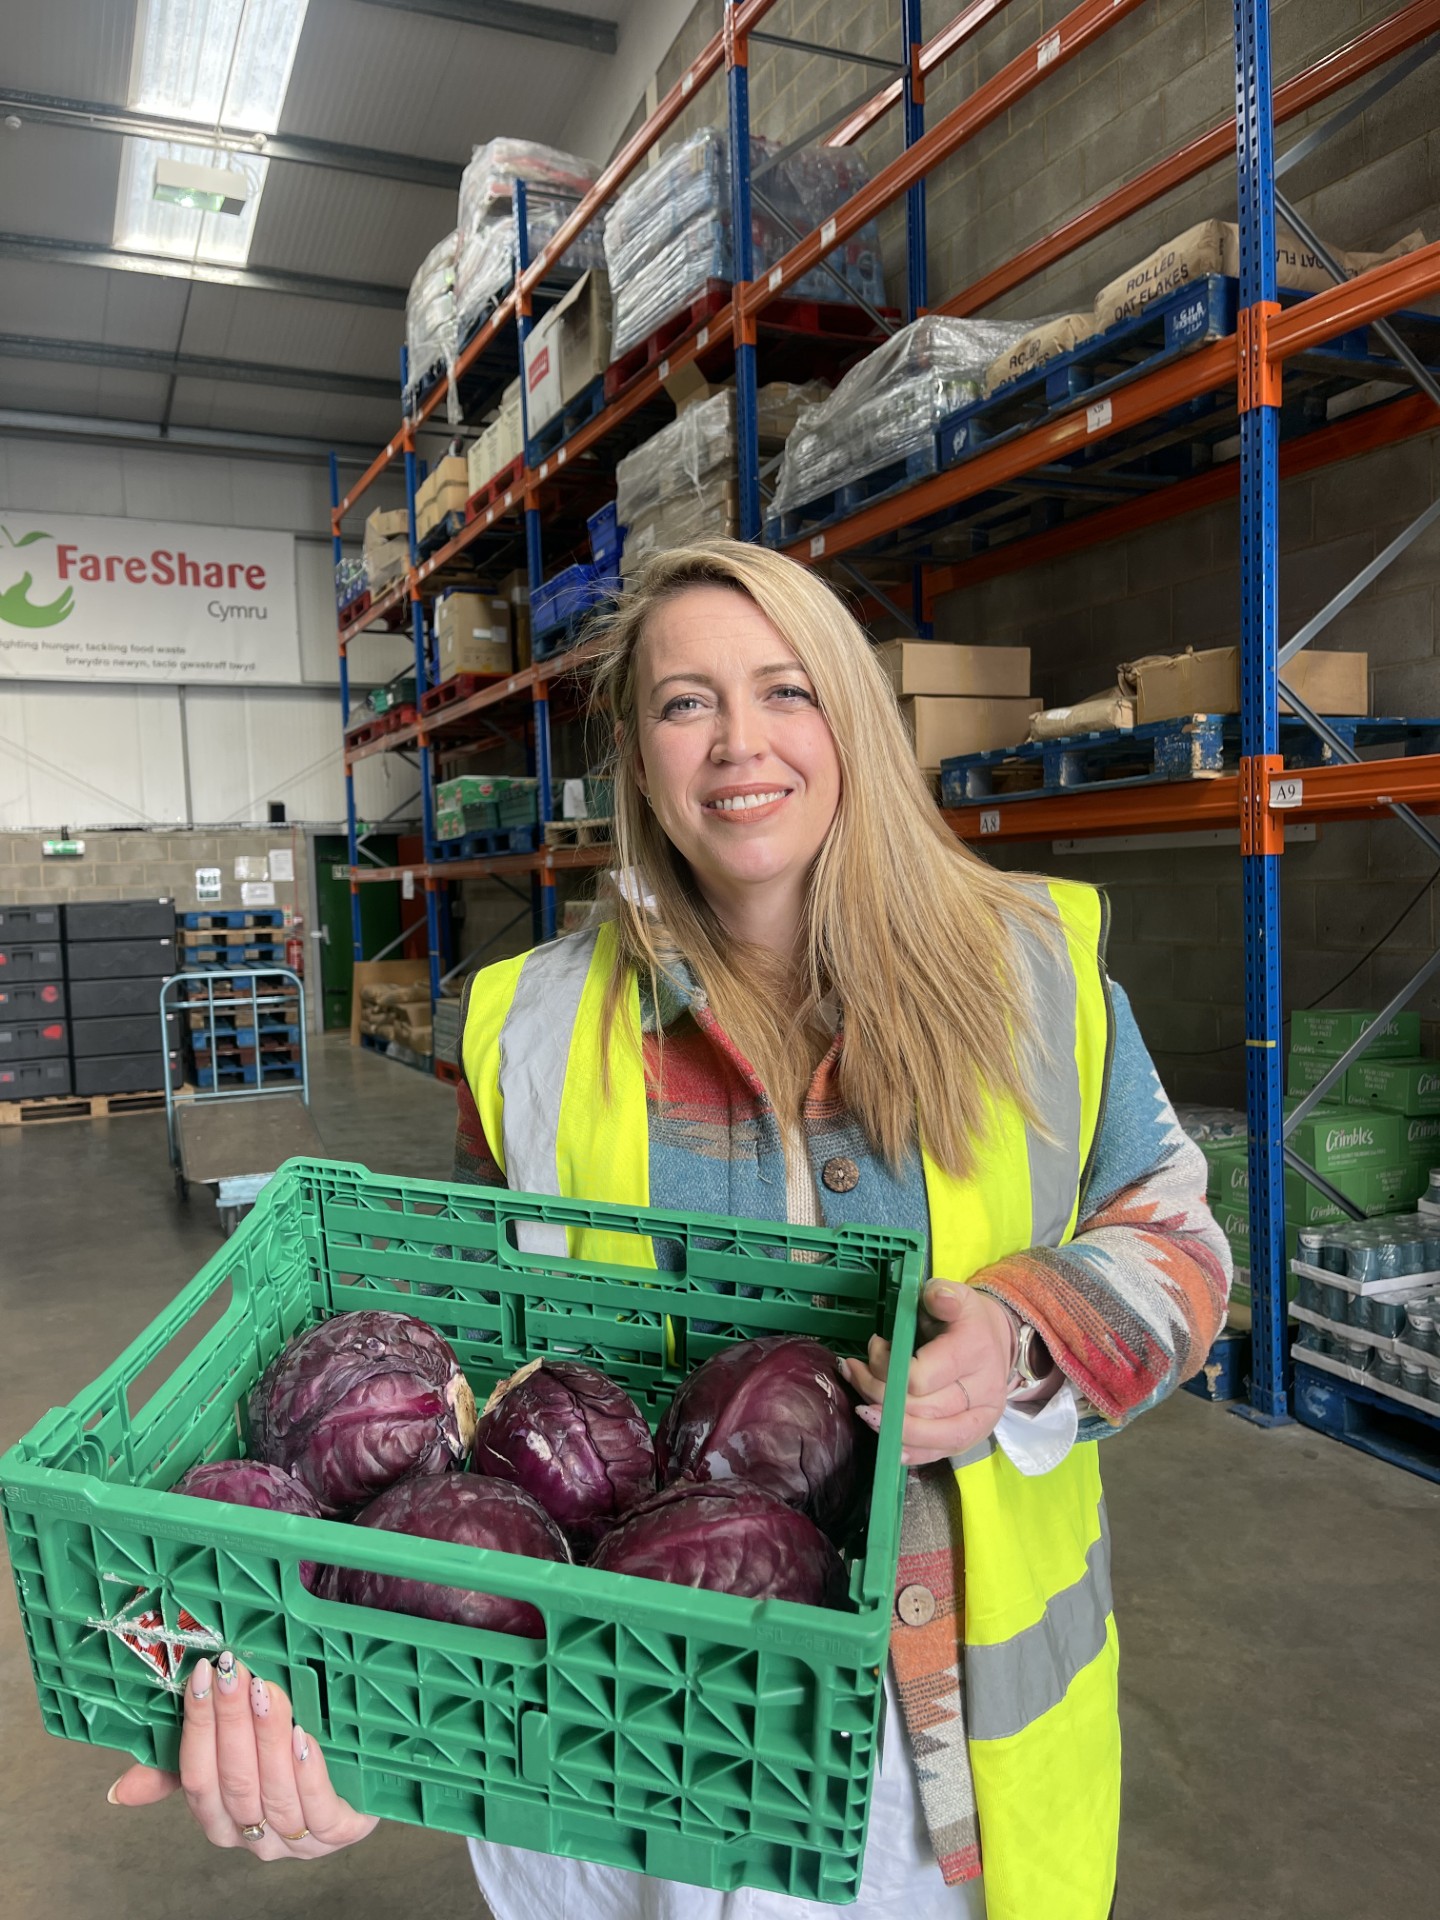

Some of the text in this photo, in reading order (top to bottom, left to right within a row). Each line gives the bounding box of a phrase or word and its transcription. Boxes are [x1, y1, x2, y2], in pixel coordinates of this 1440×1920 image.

[1126, 252, 1175, 294] ROLLED
[1114, 296, 1140, 321] OAT
[1140, 263, 1189, 304] FLAKES
[57, 544, 266, 590] FareShare
[207, 600, 268, 622] Cymru
[0, 639, 39, 650] ighting
[1276, 783, 1296, 801] A9
[982, 815, 997, 832] A8
[1326, 1126, 1374, 1152] Crimble's
